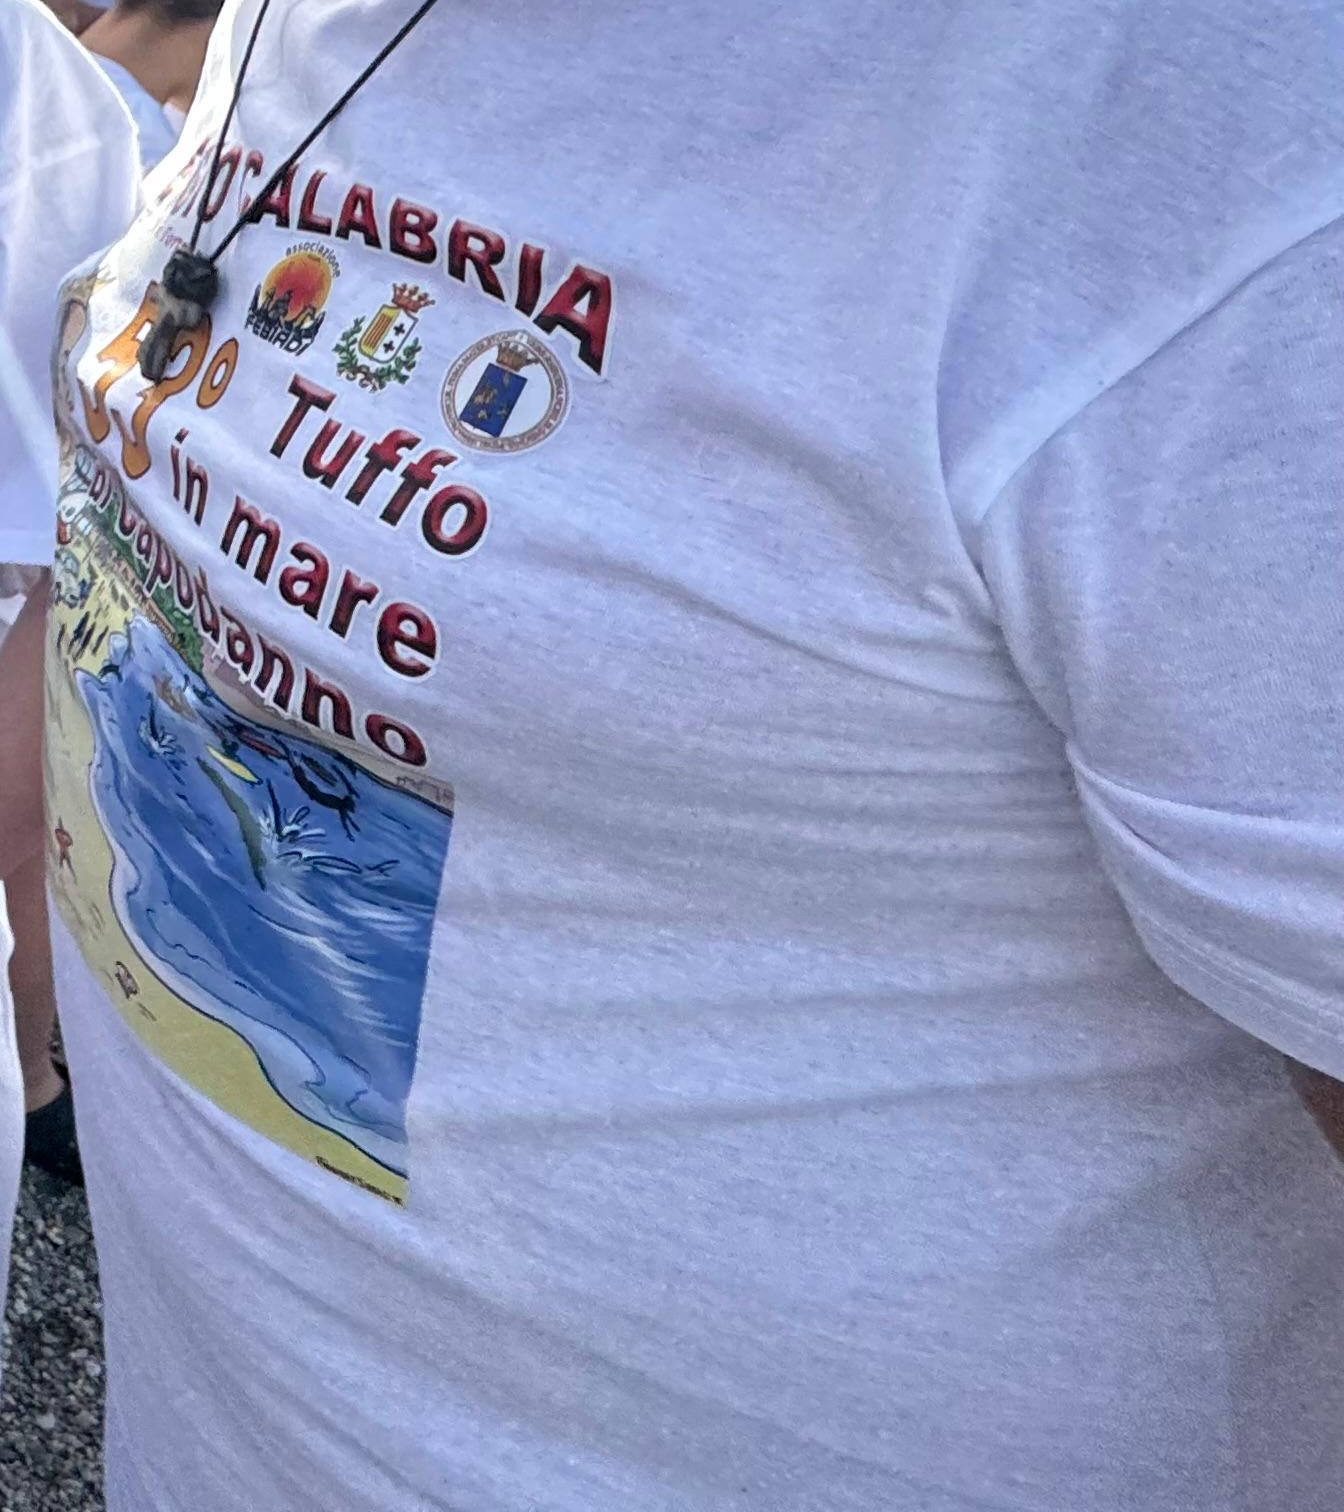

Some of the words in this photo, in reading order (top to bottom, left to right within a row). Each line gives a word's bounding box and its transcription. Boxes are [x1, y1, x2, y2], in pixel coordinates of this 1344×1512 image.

[169, 427, 210, 527] in
[218, 493, 440, 679] mare
[269, 374, 489, 555] Tuffo
